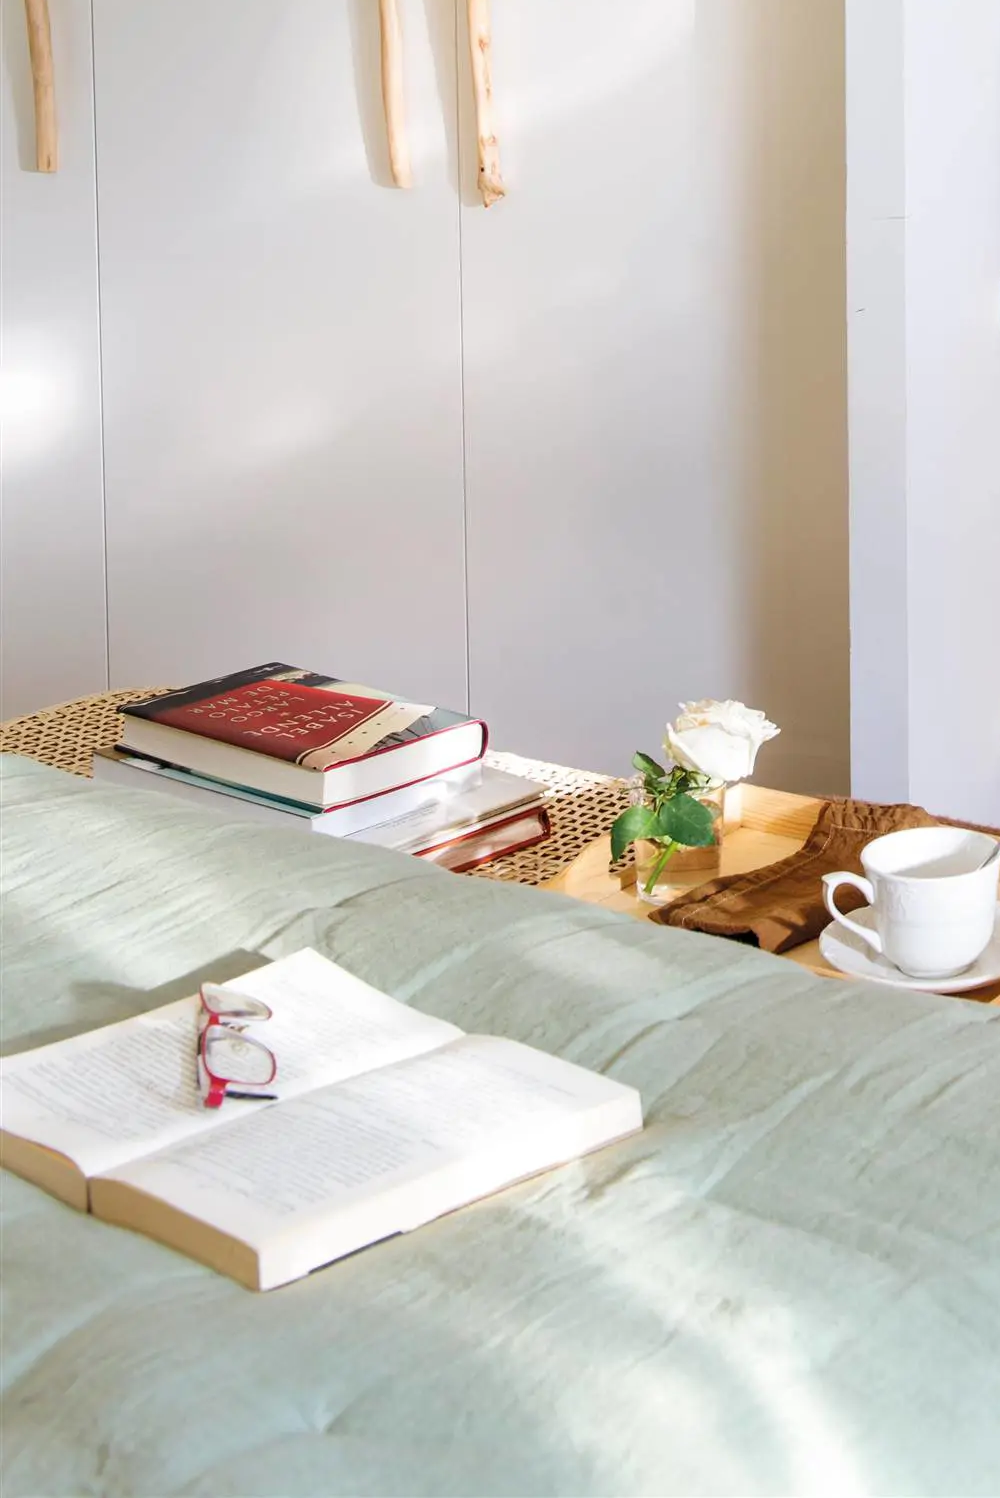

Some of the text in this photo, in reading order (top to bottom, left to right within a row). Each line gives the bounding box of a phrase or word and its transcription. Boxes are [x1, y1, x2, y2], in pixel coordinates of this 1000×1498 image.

[188, 685, 273, 714] DE MAR
[231, 696, 305, 723] LARGO
[243, 700, 355, 738] ALLENDE
[276, 709, 364, 739] ISABEL
